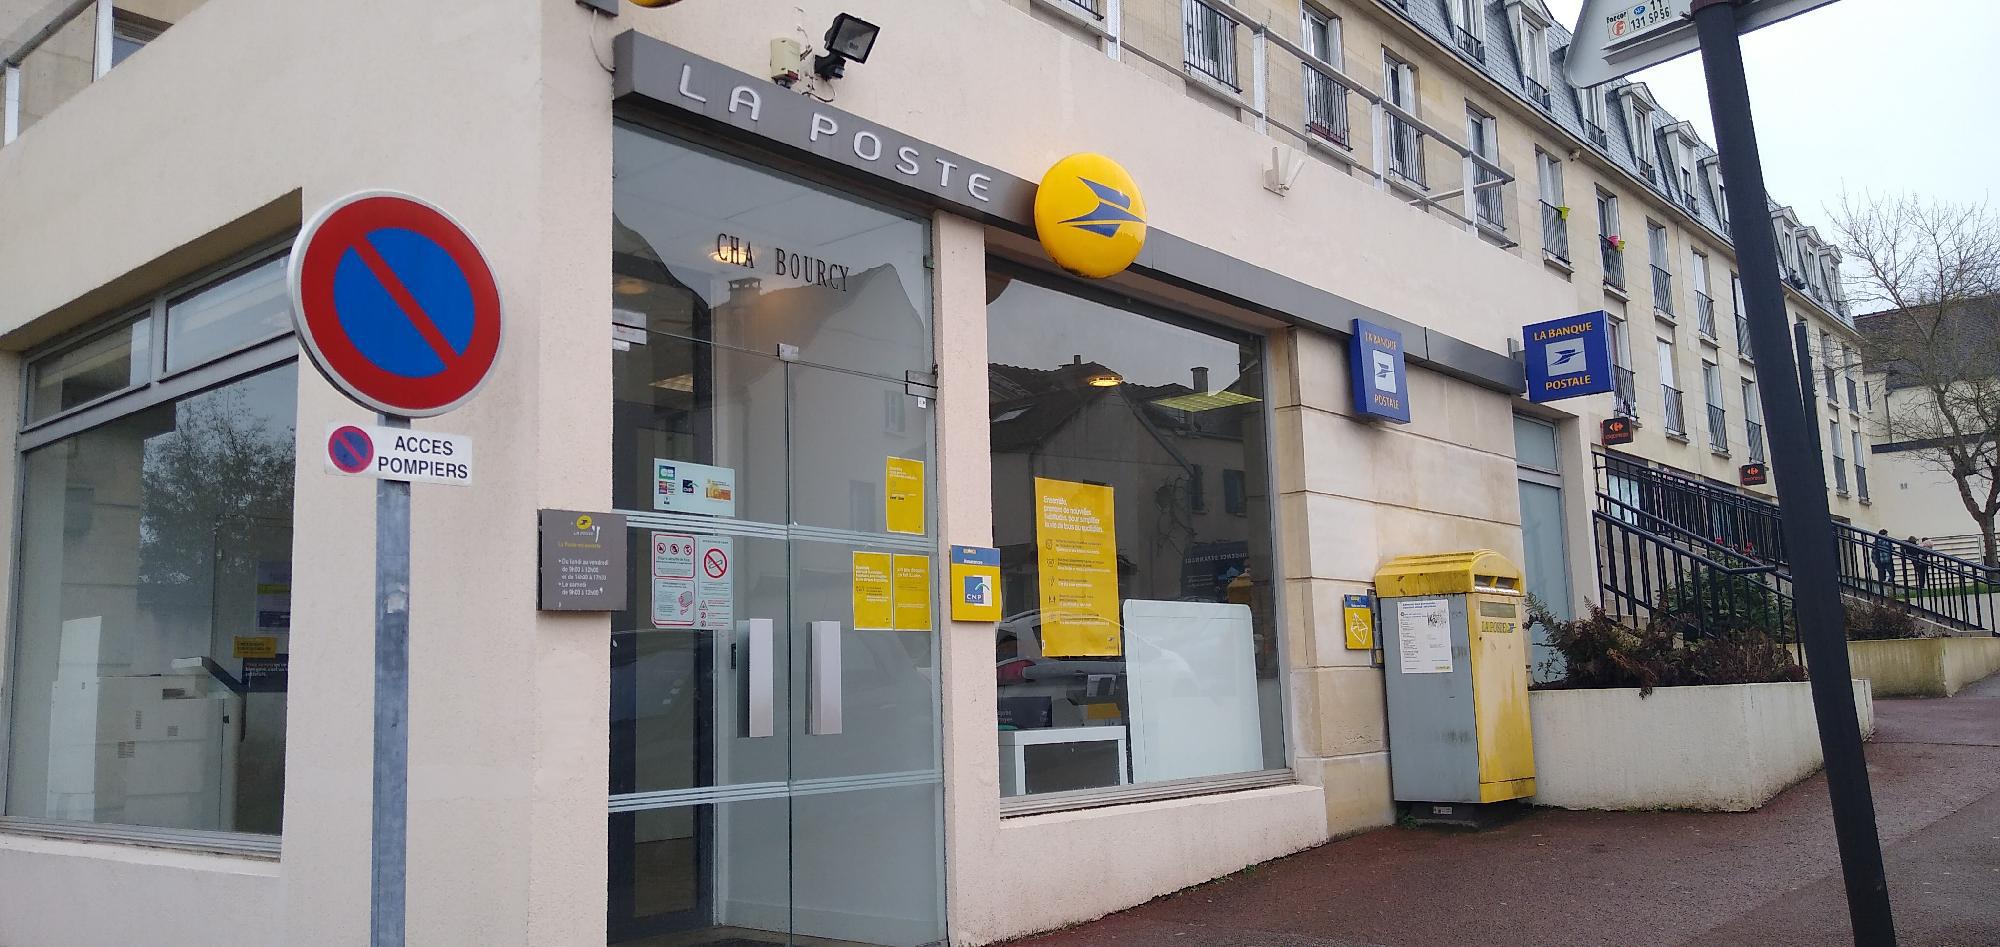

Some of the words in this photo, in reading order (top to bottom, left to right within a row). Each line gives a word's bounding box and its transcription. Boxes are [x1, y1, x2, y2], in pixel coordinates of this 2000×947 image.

[1631, 16, 1646, 30] 131
[679, 64, 762, 121] LA
[809, 112, 993, 203] POSTE
[775, 247, 850, 293] BOURCY
[1364, 330, 1372, 342] LA
[1374, 334, 1397, 350] BANQUE
[1534, 330, 1546, 341] LA
[1548, 322, 1592, 338] BANQUE
[1546, 374, 1592, 390] POSTALE
[1374, 394, 1399, 410] POSTALE
[395, 436, 453, 456] ACCES
[378, 456, 468, 479] POMPIERS
